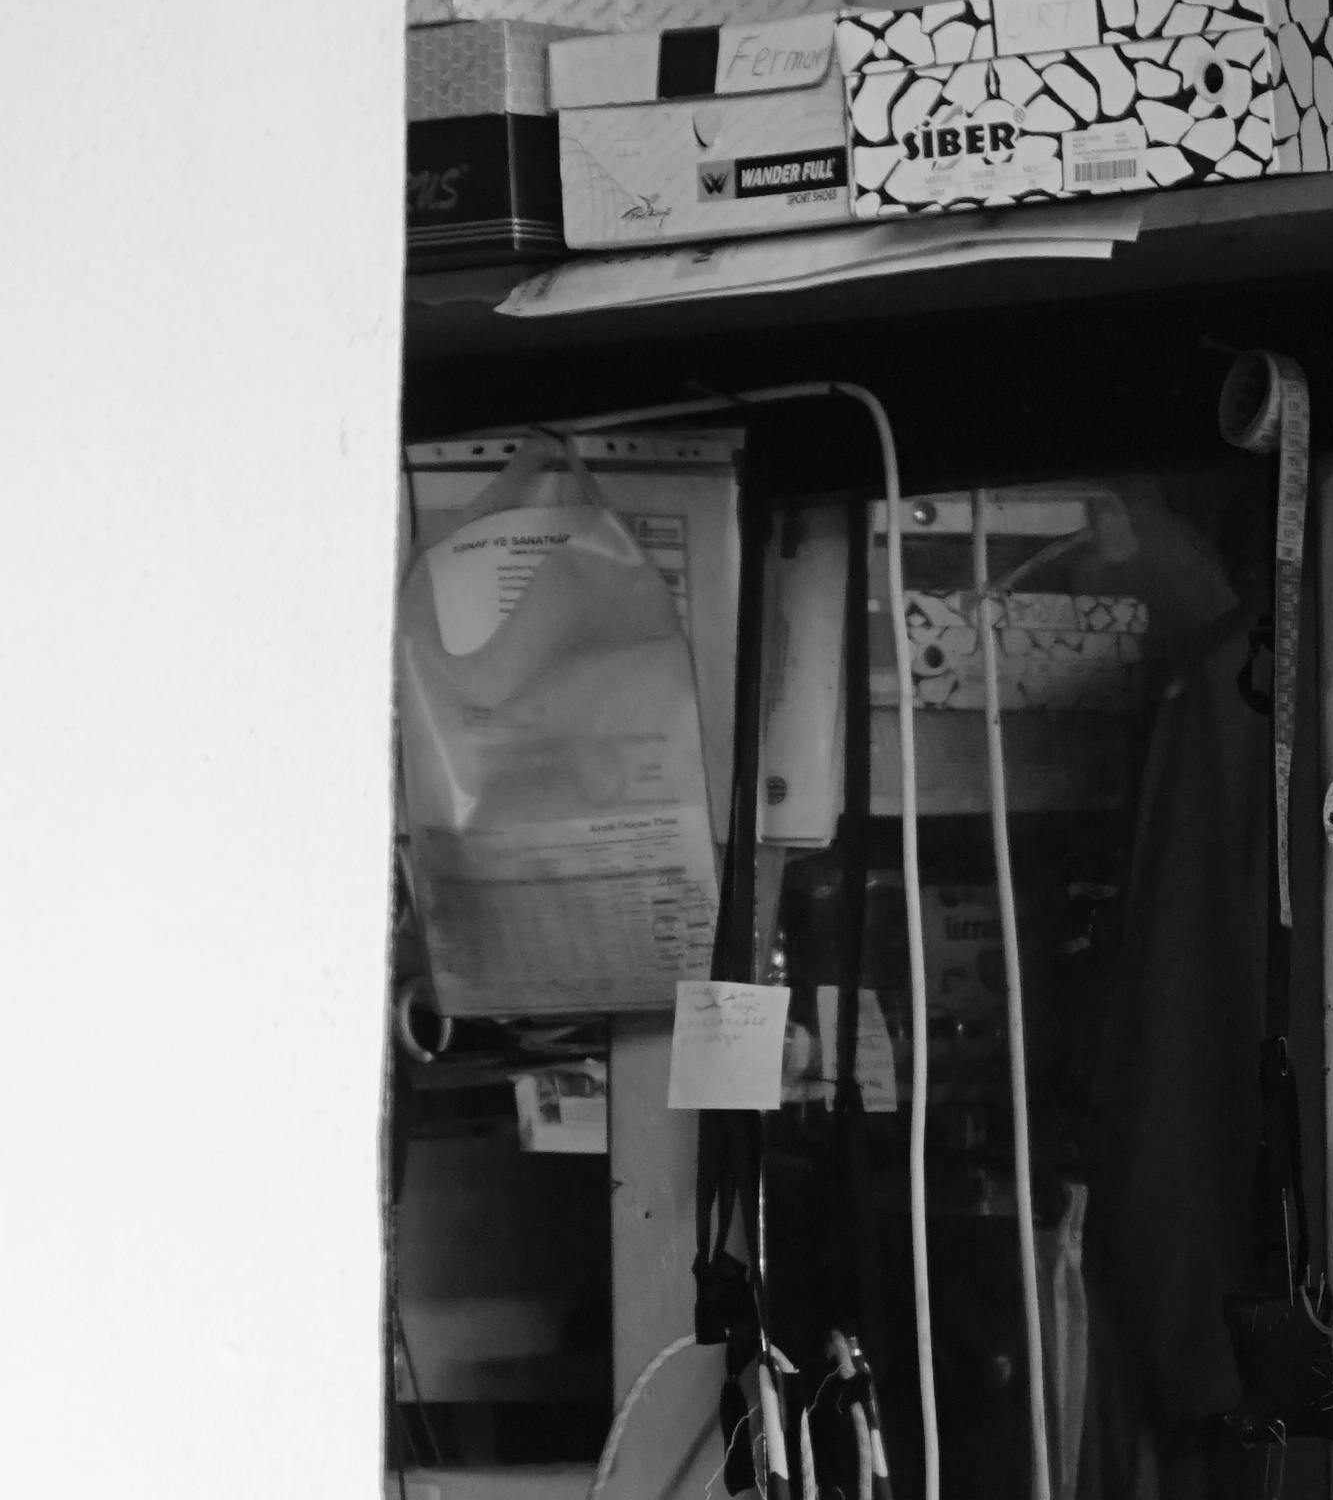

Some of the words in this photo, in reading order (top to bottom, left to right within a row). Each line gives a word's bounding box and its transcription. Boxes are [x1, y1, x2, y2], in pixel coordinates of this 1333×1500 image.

[901, 118, 1016, 162] SİBER
[741, 163, 801, 188] WANDER
[802, 159, 834, 181] FULL
